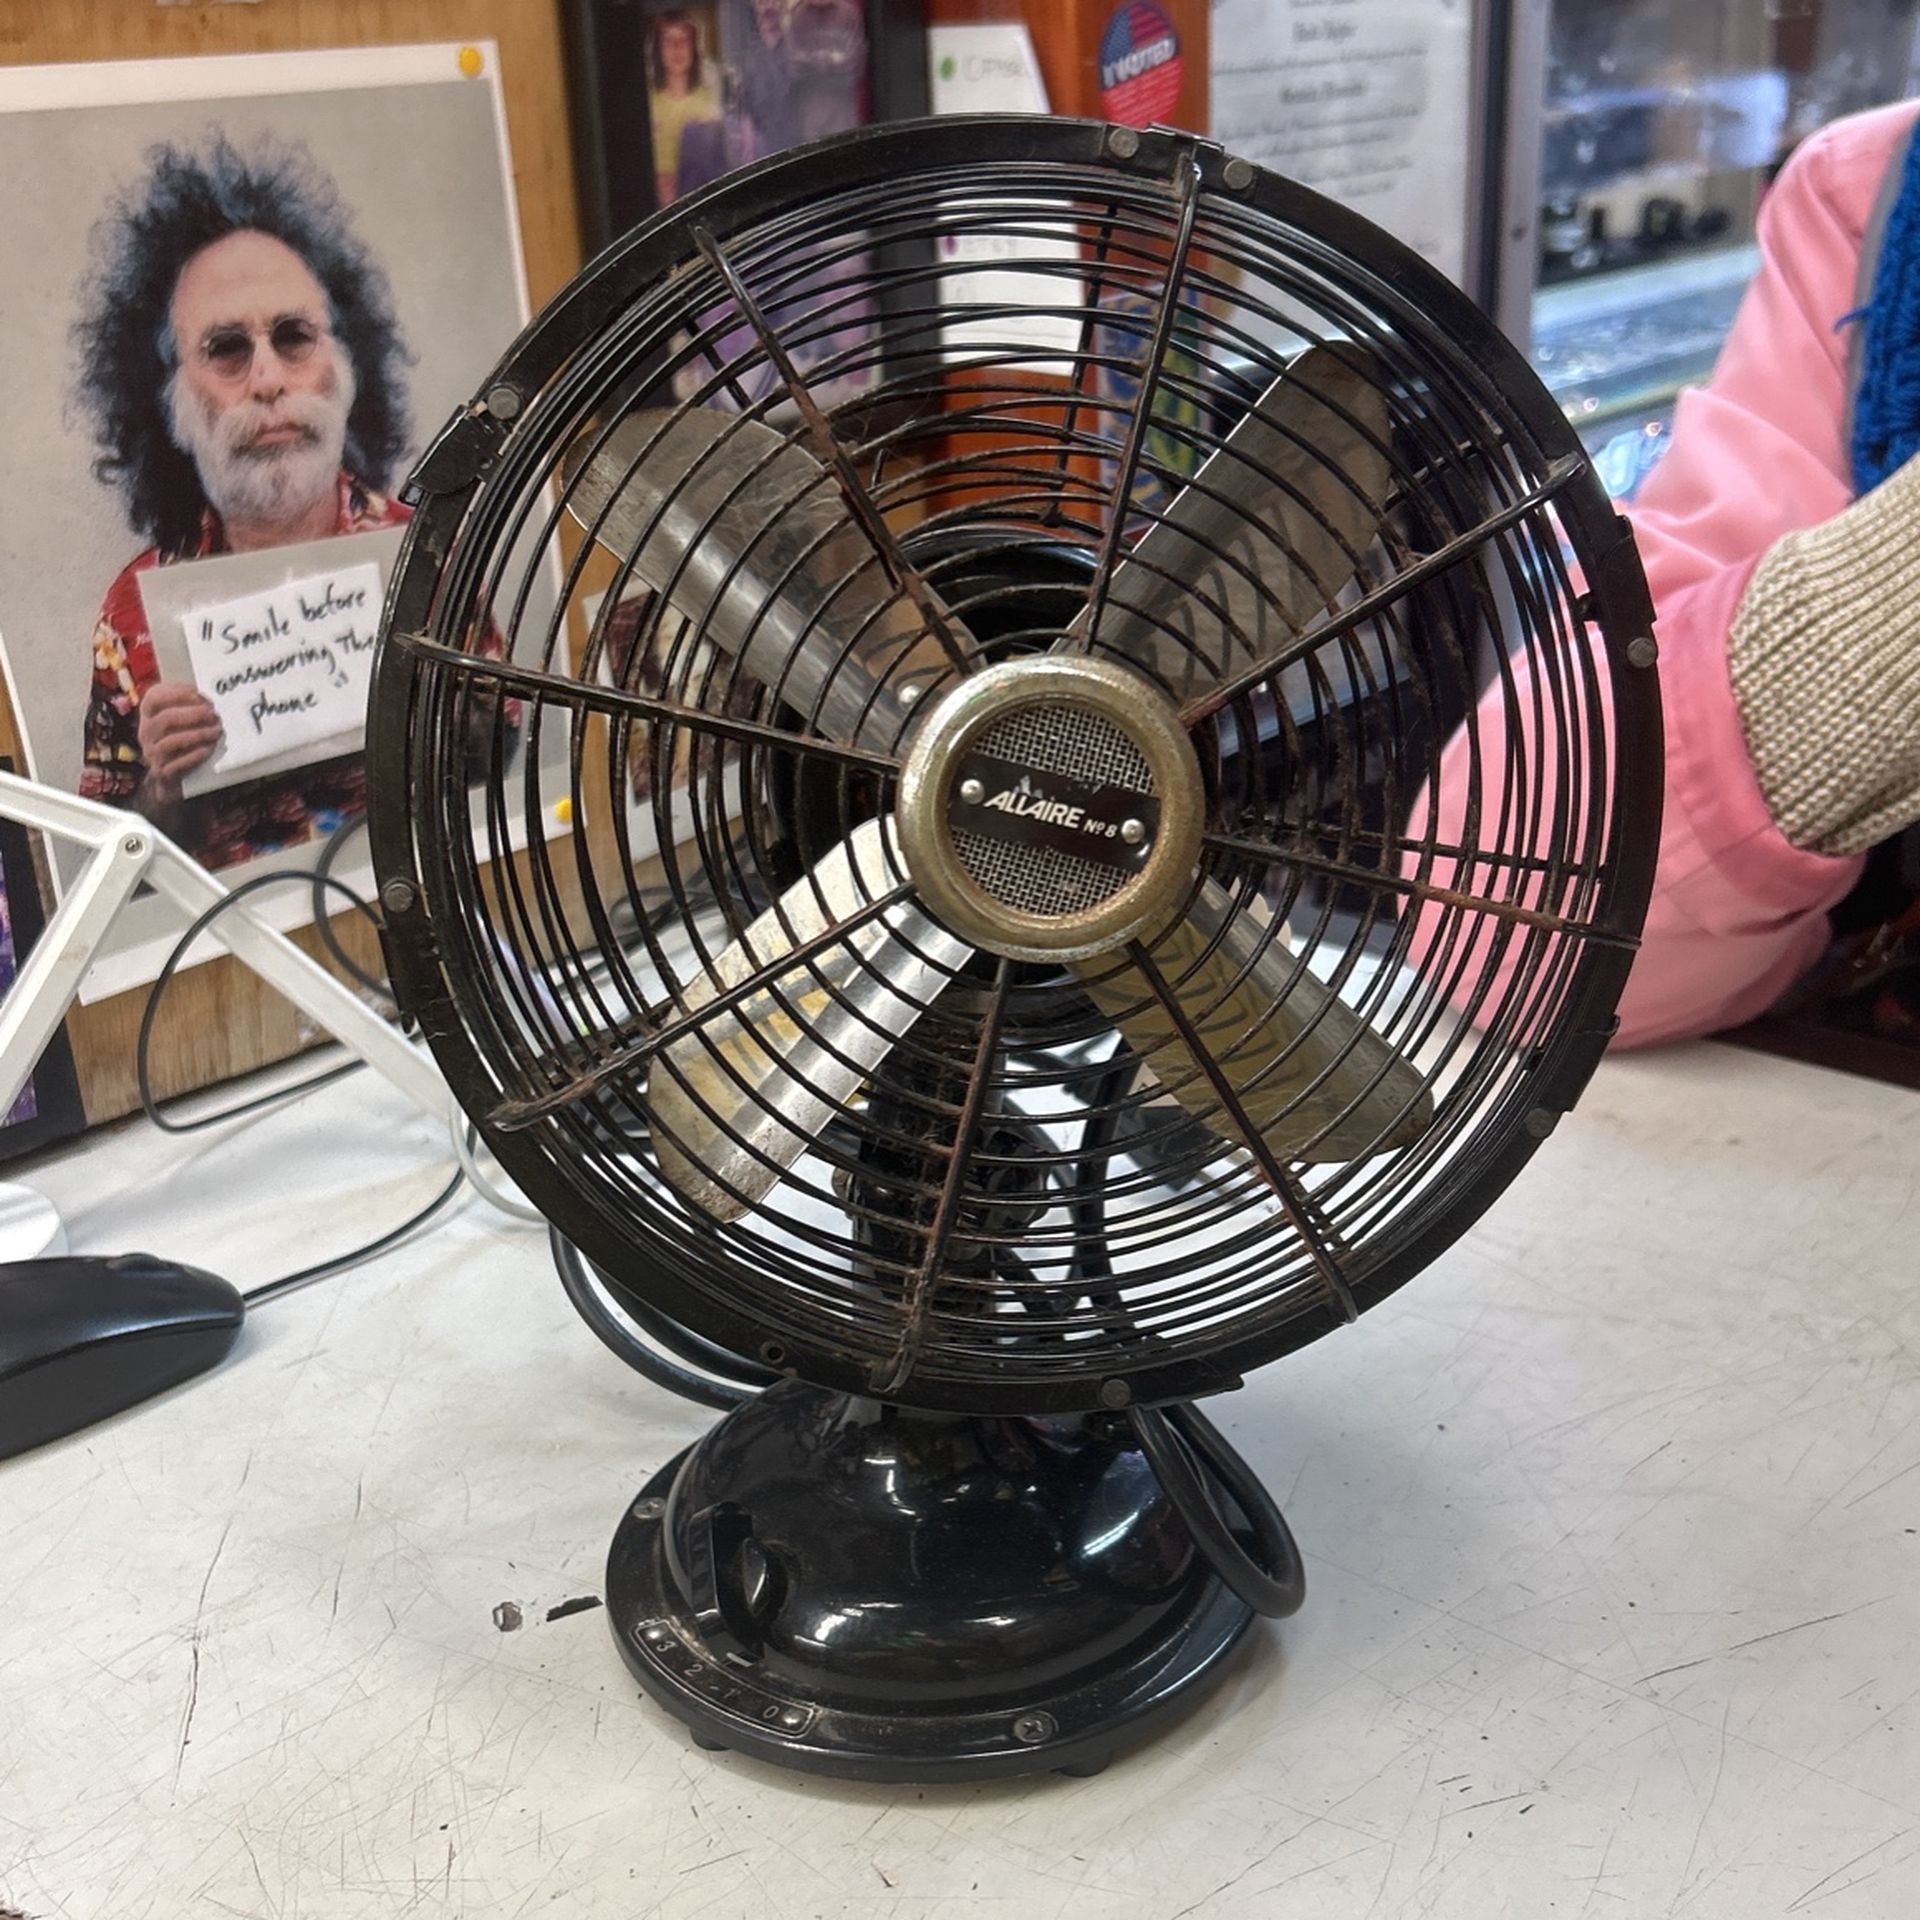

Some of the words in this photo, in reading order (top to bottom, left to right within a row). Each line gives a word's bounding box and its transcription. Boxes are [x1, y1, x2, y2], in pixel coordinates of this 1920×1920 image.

[299, 582, 366, 622] before
[214, 640, 336, 695] answering
[984, 790, 1086, 829] ALLAIRE
[1104, 823, 1118, 839] 8
[656, 1640, 677, 1653] 3
[683, 1663, 704, 1678] 2
